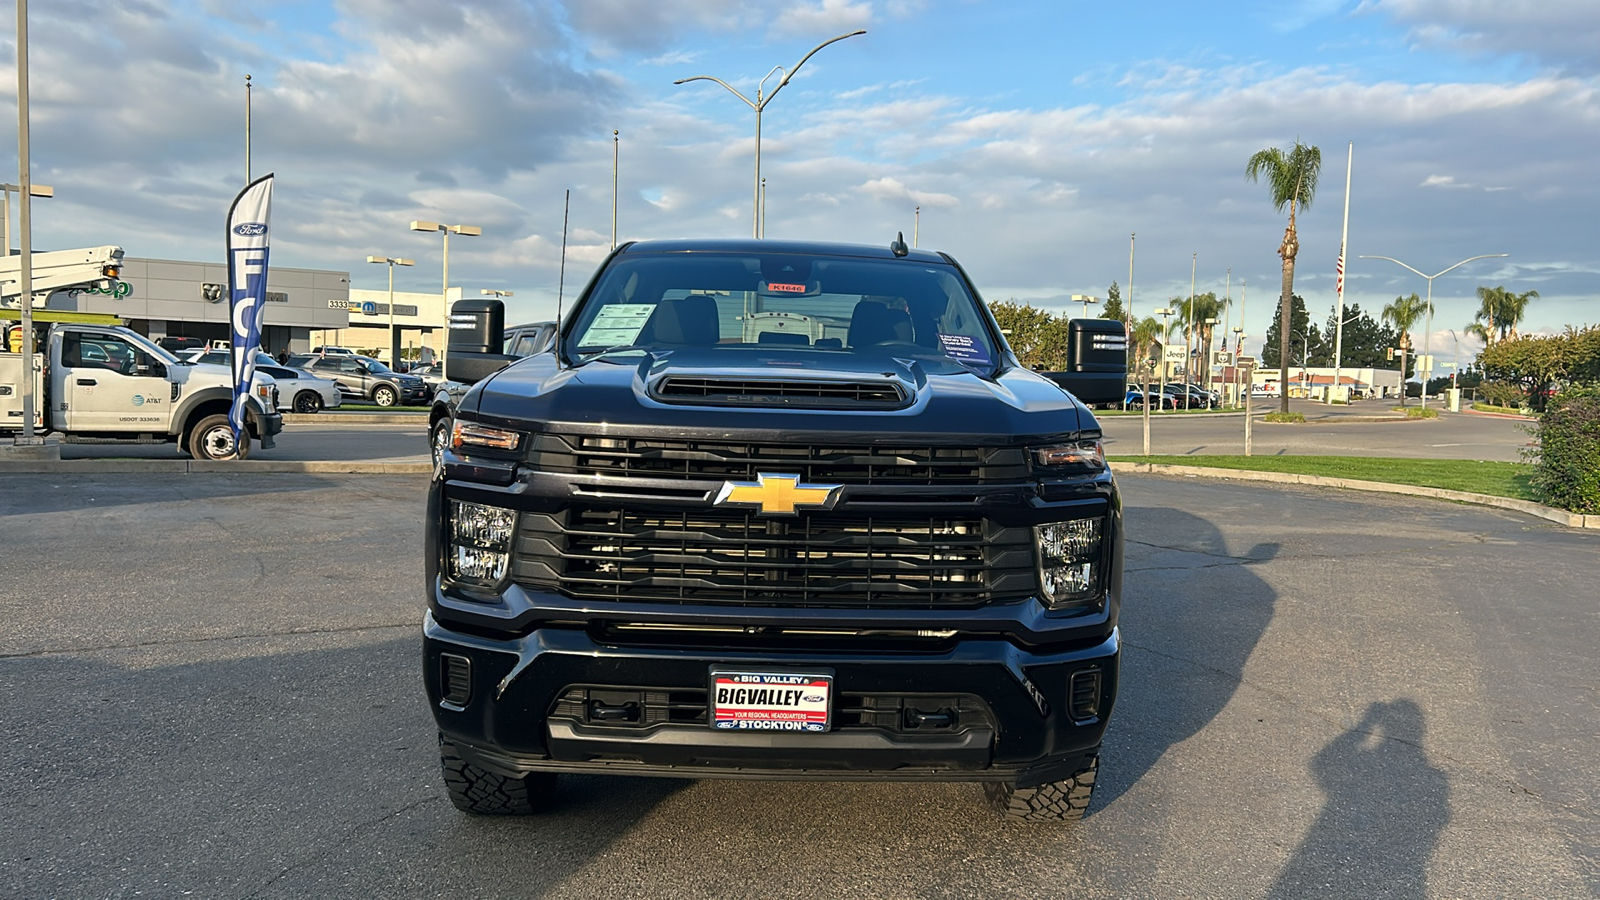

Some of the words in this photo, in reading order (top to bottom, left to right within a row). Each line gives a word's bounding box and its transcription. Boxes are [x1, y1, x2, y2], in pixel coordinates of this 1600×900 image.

[329, 300, 348, 309] 3333
[378, 305, 412, 314] Sevice
[1166, 350, 1186, 359] Jeep
[1252, 384, 1276, 392] FedEx
[741, 675, 761, 683] BIG
[763, 676, 804, 684] VALLEY
[739, 720, 802, 730] STOCKTON
